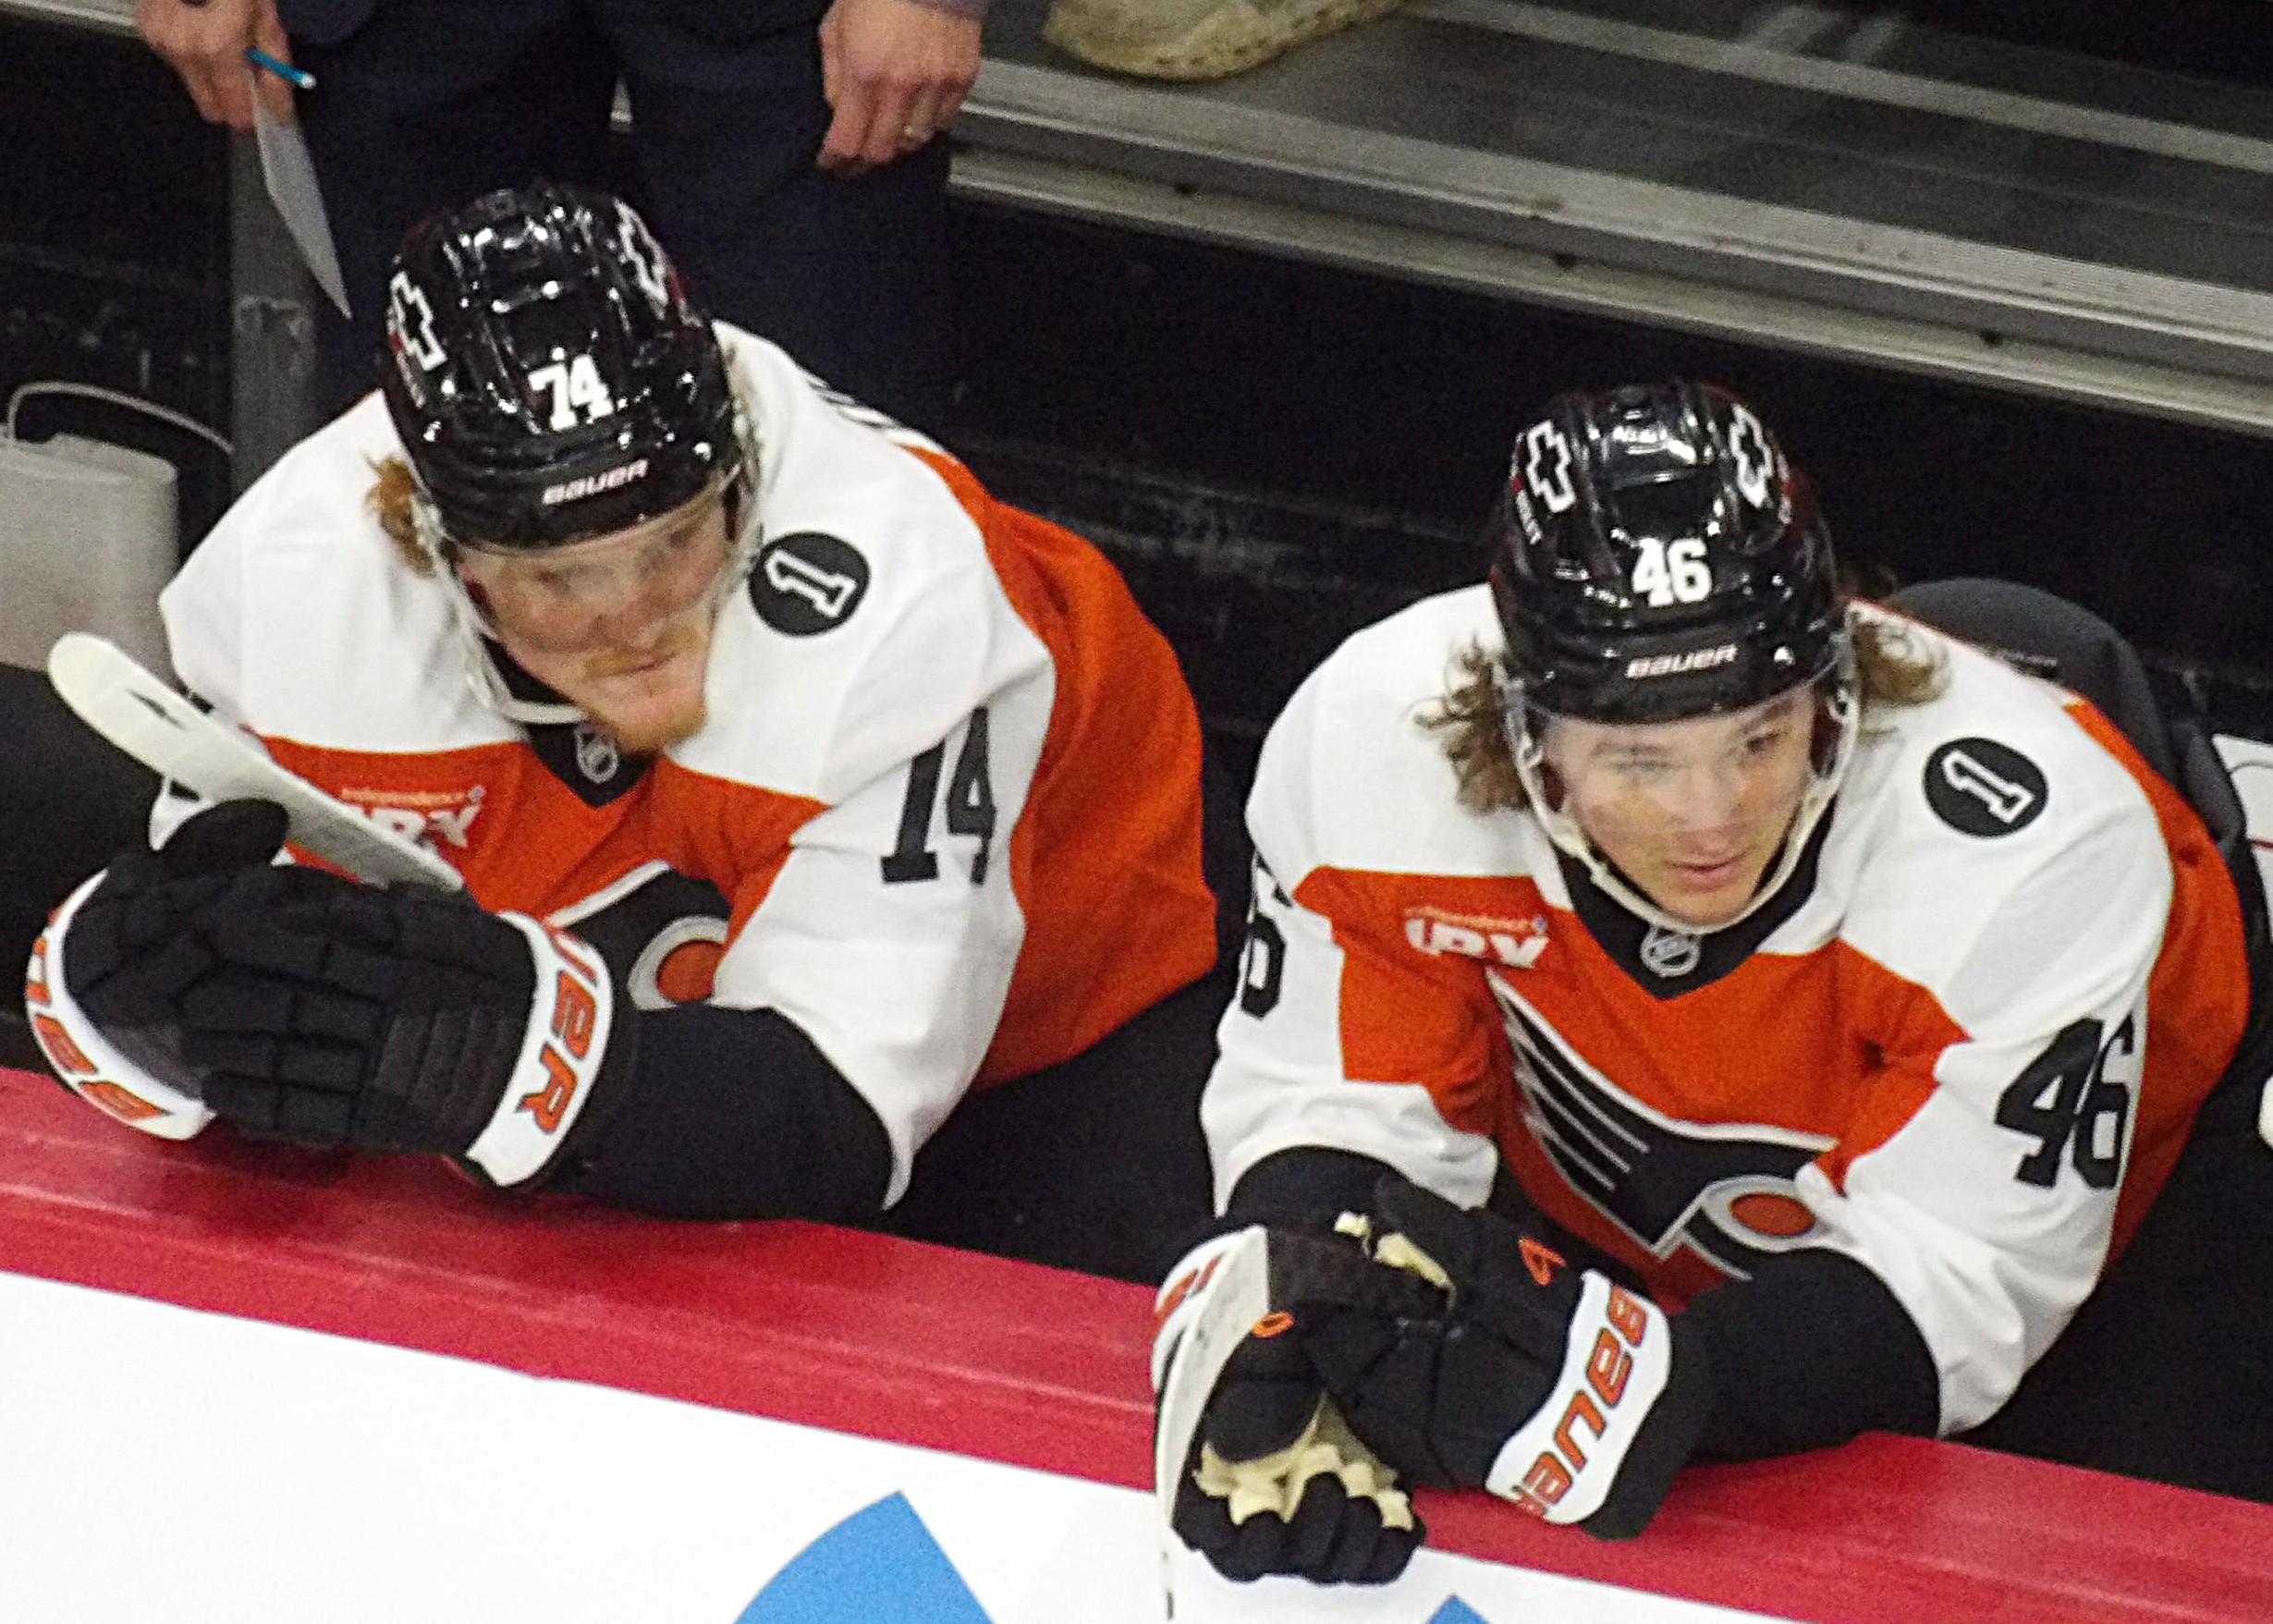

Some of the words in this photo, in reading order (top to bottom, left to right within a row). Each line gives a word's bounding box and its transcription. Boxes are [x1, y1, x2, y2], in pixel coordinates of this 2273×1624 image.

[528, 353, 616, 432] 74
[541, 458, 649, 506] BAUER
[764, 548, 861, 618] 1
[1631, 536, 1713, 608] 46
[1624, 642, 1740, 679] BAUER
[1939, 749, 2036, 824] 1
[1993, 1009, 2135, 1191] 46
